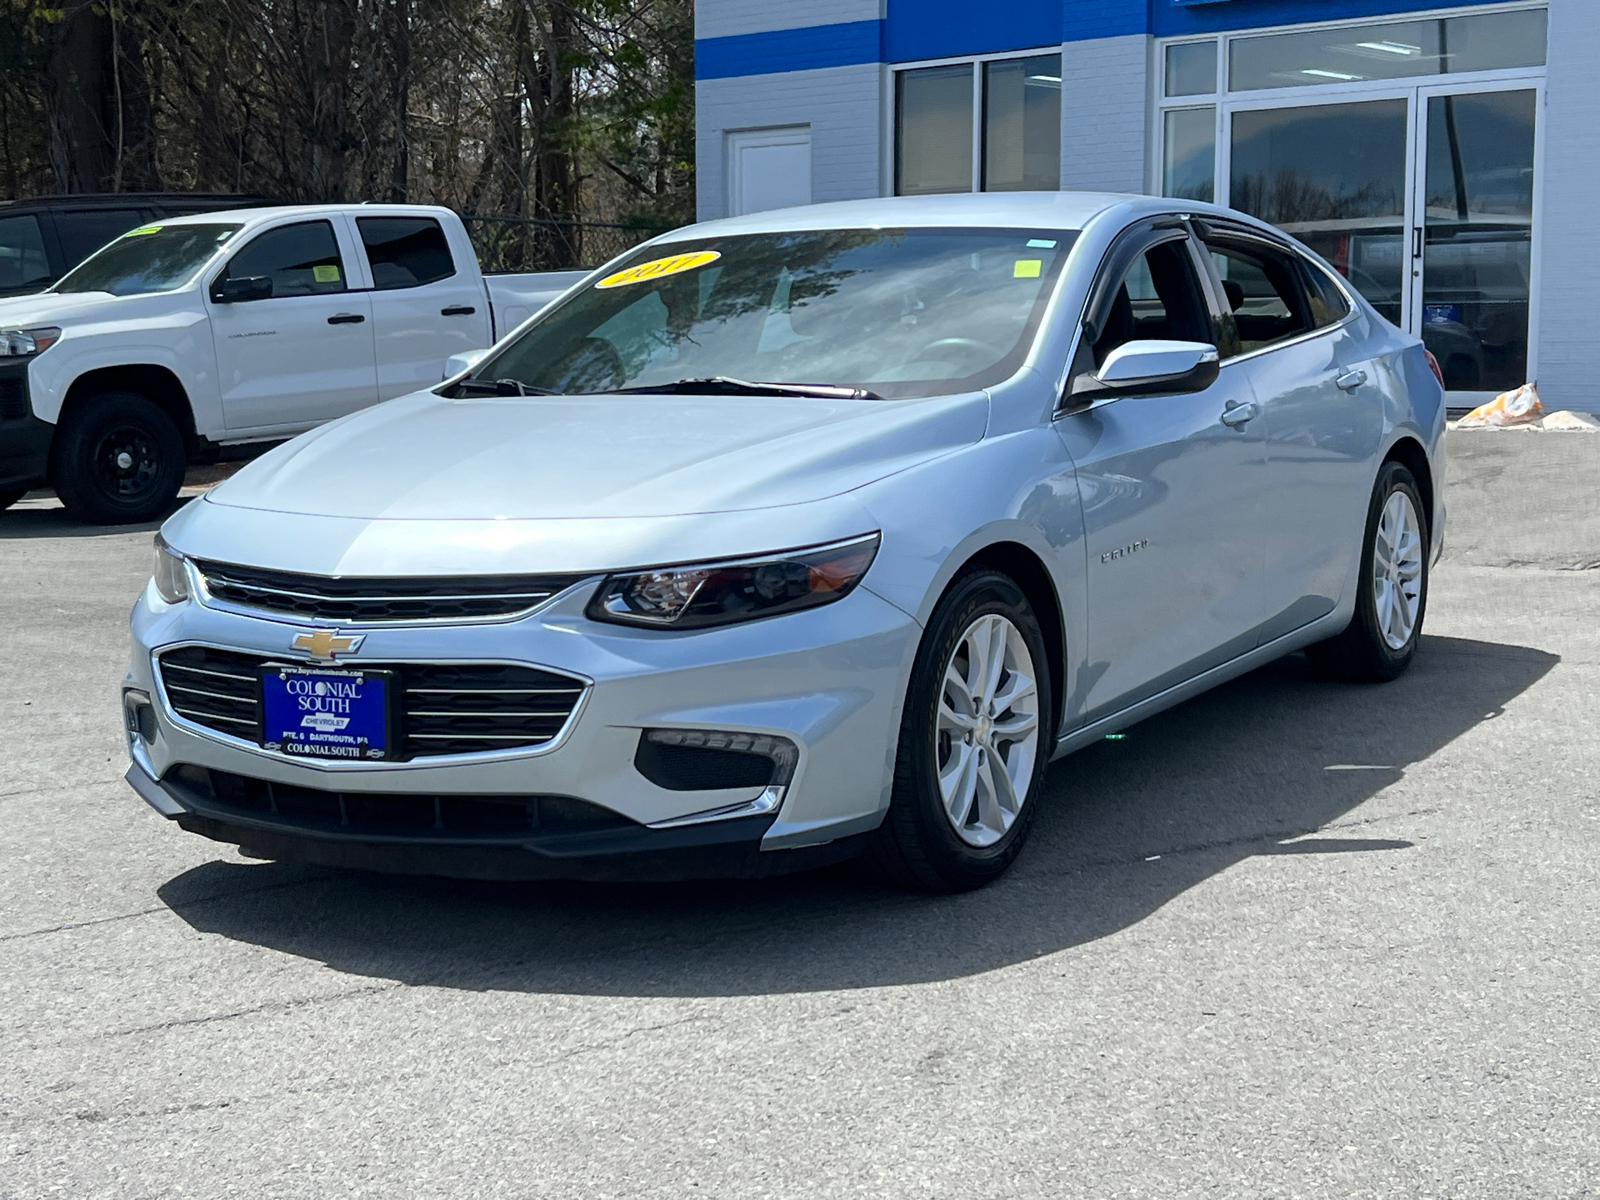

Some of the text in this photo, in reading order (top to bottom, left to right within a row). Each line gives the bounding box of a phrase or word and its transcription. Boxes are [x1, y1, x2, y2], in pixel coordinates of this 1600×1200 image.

[610, 254, 702, 284] 2017
[286, 679, 362, 698] COLONIAL
[298, 696, 350, 713] SOUTH
[305, 717, 345, 727] CHEVROLET
